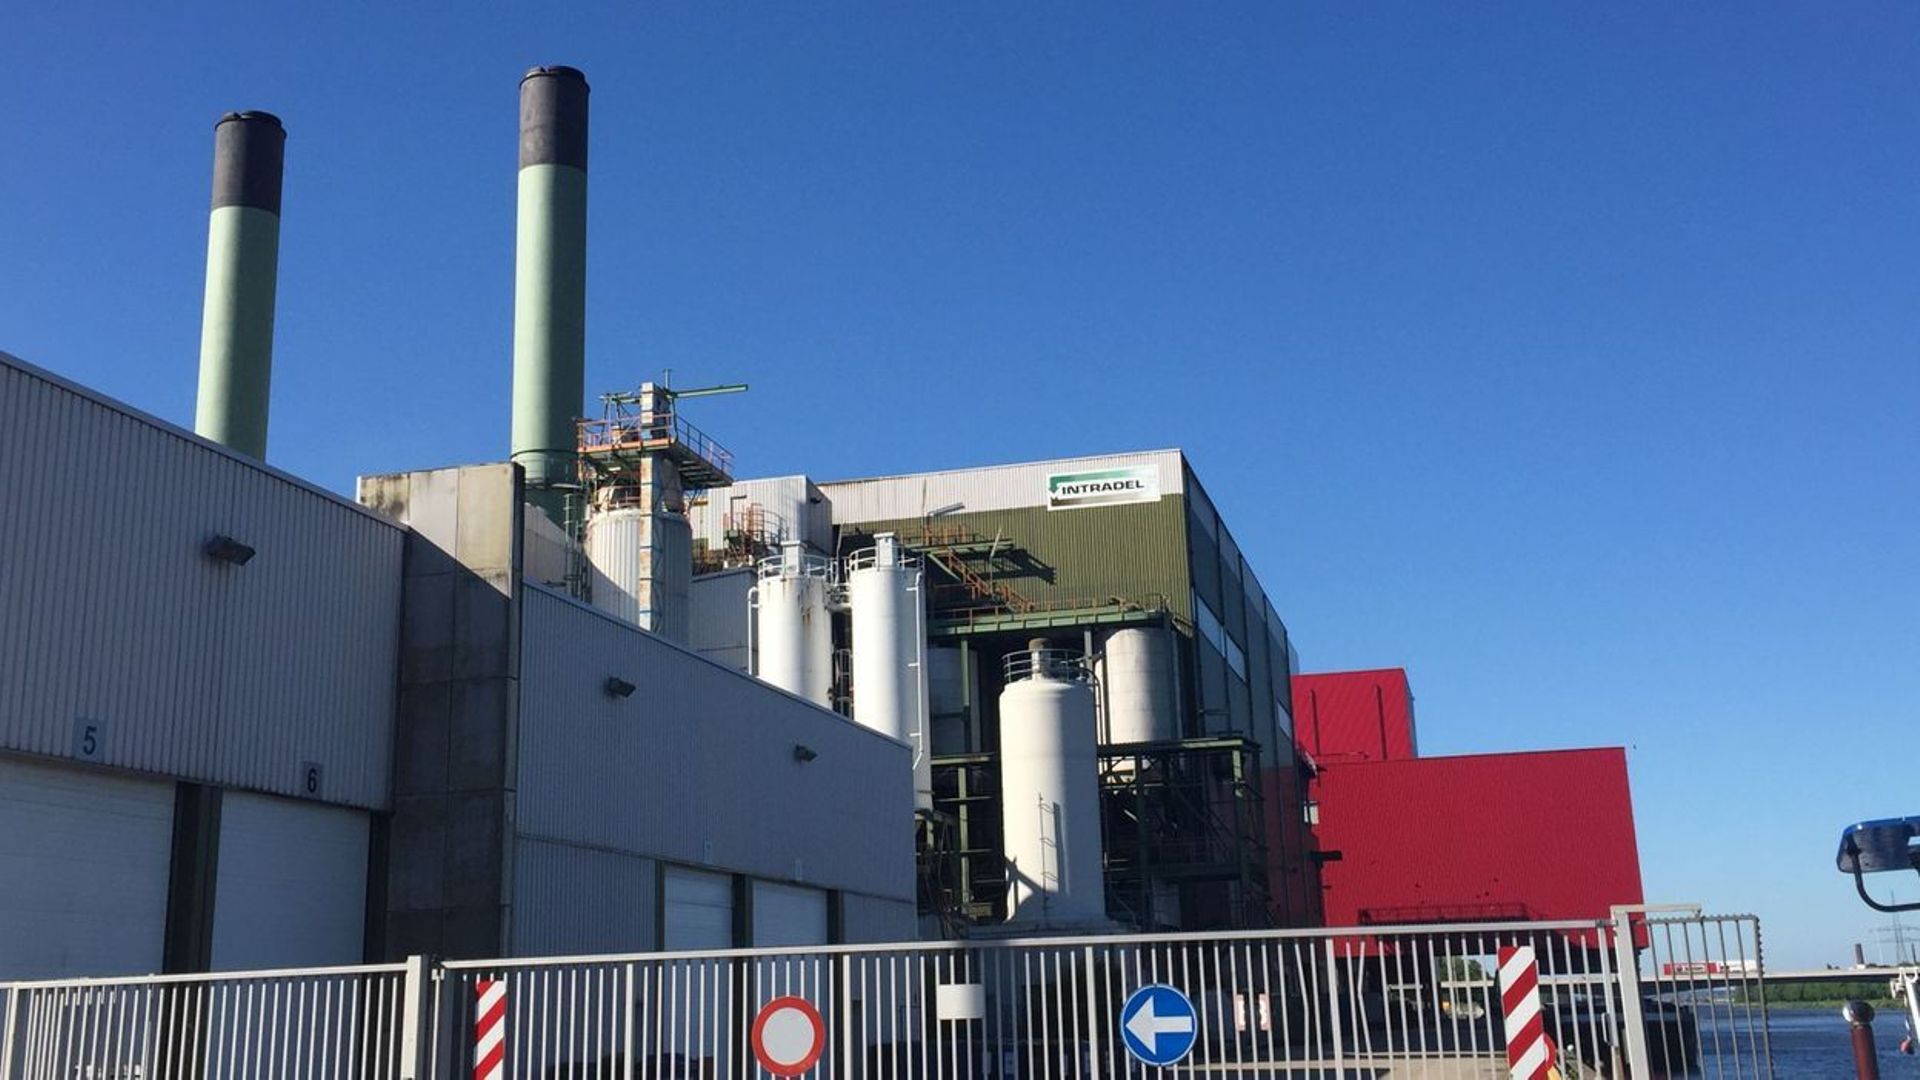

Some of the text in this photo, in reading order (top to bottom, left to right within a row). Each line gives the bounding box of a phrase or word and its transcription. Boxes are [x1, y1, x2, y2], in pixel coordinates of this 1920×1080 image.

[1062, 480, 1144, 495] INTRADEL
[83, 726, 97, 755] 5
[307, 768, 317, 793] 6
